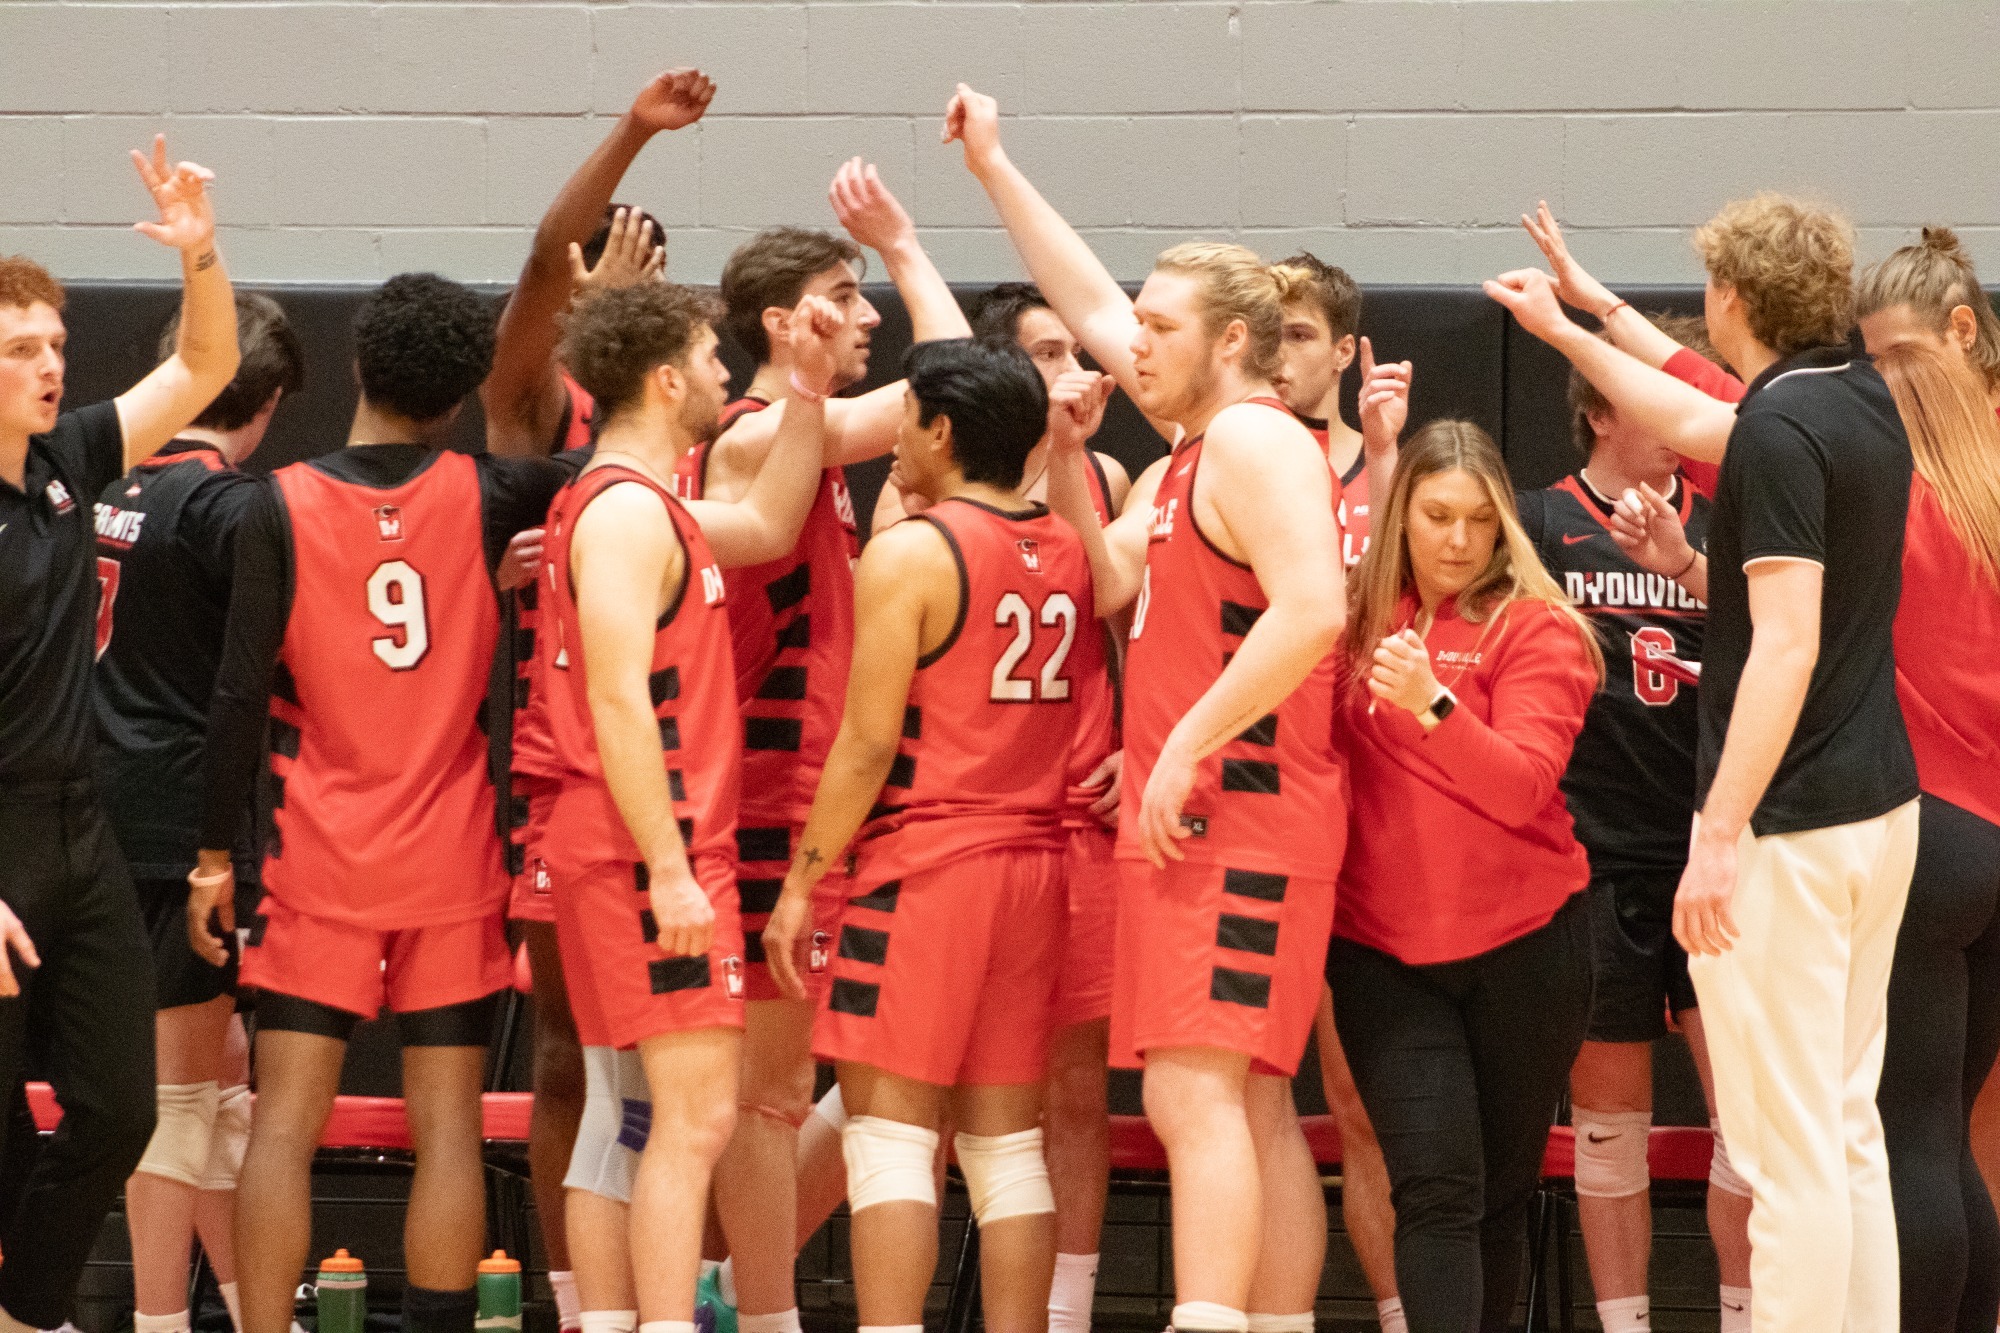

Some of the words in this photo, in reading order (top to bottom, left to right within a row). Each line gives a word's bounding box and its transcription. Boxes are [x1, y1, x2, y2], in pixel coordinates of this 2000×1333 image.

[366, 559, 431, 671] 9
[1565, 571, 1708, 610] D'YOUVIL
[989, 591, 1078, 702] 22
[1631, 626, 1679, 706] 6
[1193, 821, 1204, 832] XL
